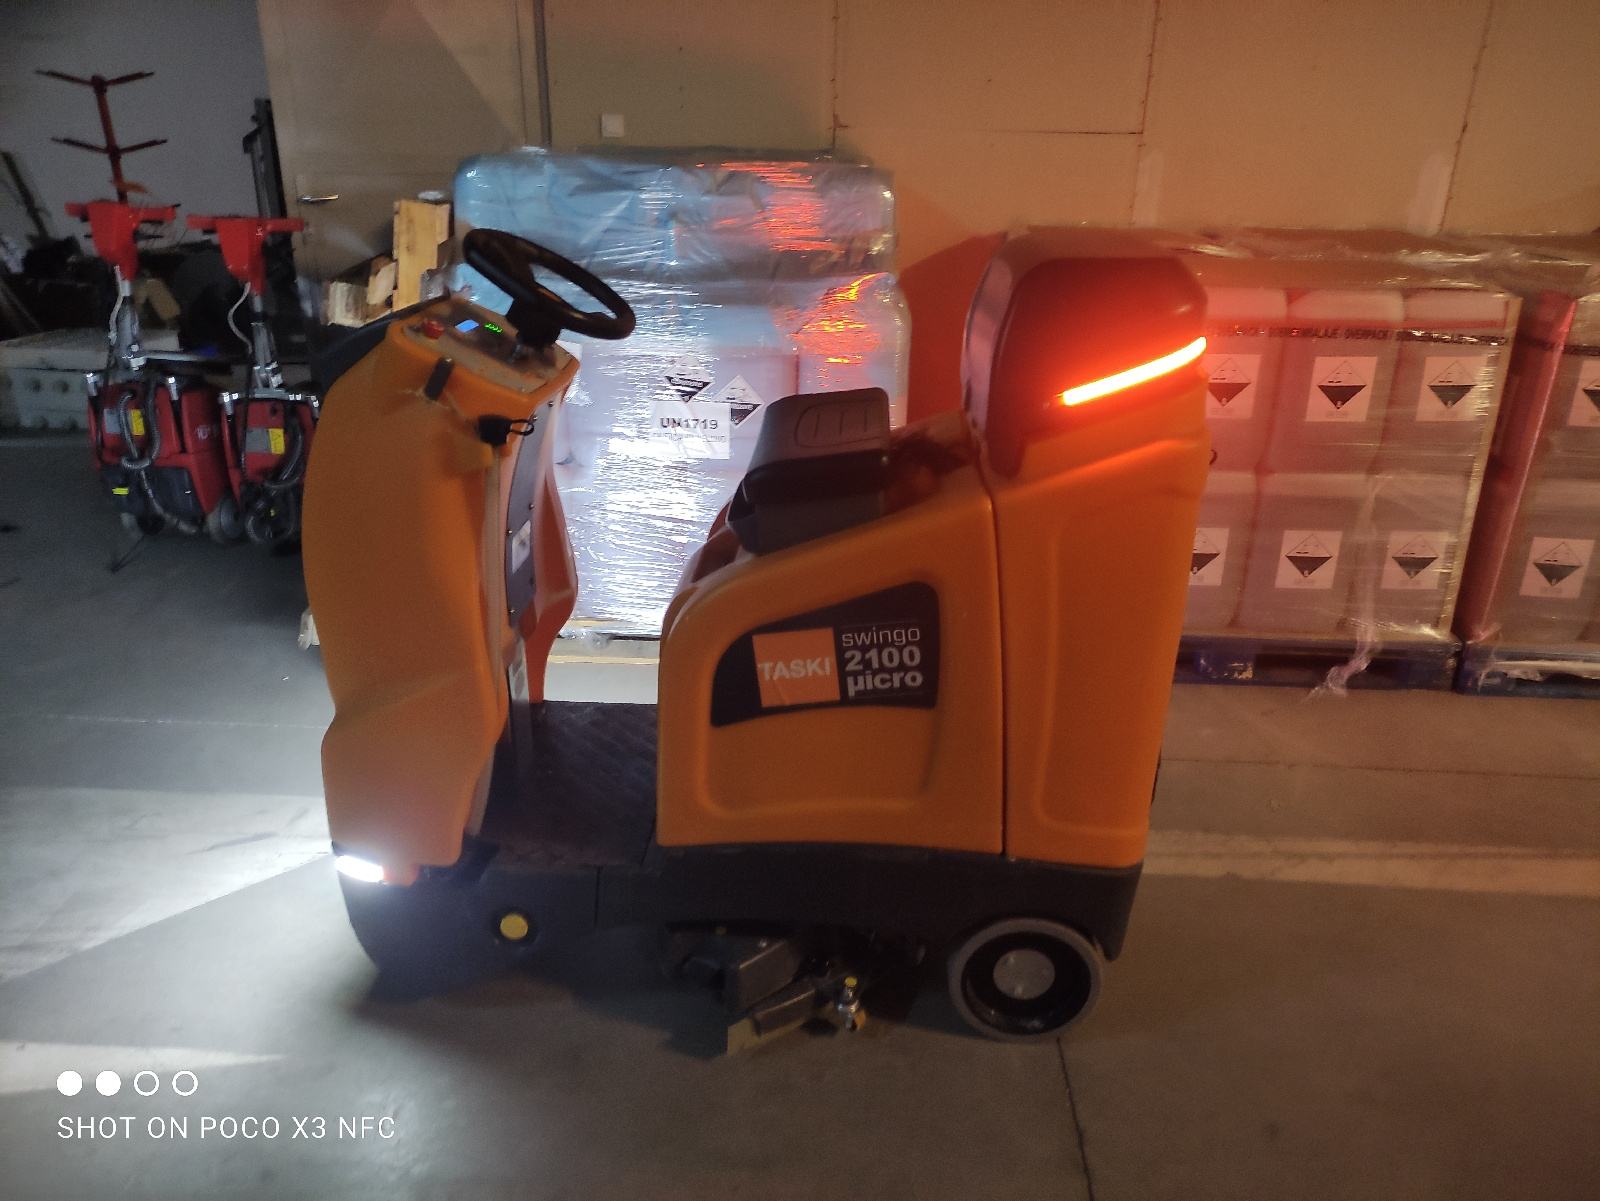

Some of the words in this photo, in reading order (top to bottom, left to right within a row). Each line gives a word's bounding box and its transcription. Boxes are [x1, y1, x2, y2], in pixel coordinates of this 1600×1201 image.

[659, 417, 719, 430] UN1719
[841, 626, 921, 647] swingo
[758, 656, 832, 682] TASKI
[844, 646, 921, 671] 2100
